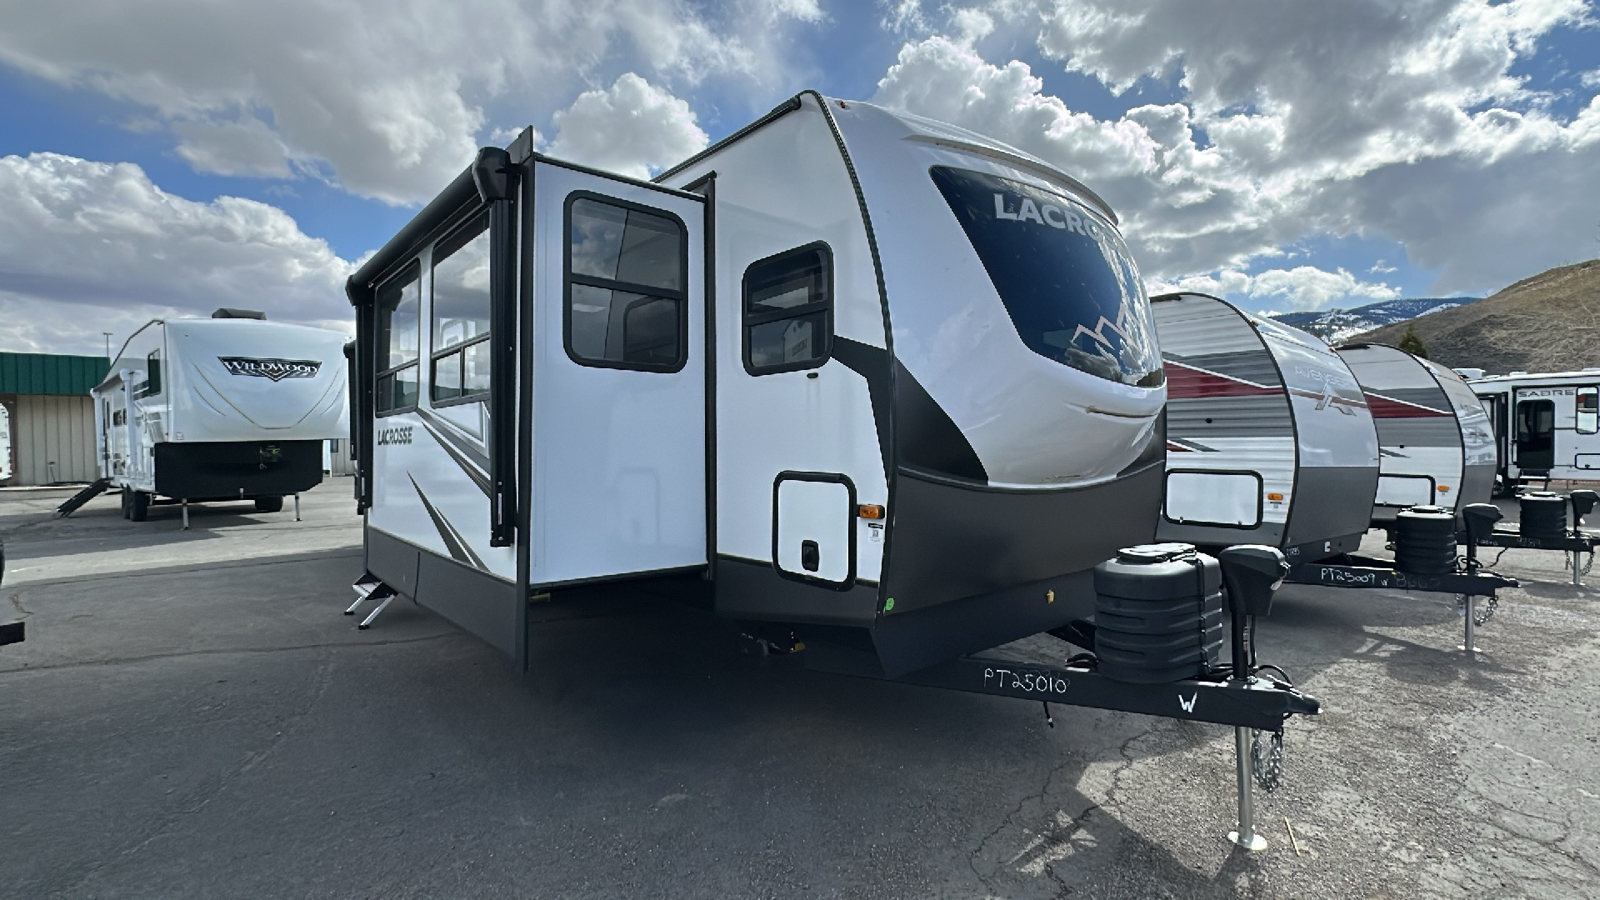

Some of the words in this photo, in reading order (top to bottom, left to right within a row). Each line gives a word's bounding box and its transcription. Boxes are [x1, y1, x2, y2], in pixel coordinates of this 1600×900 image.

[223, 361, 318, 373] WILDWOOD
[1517, 389, 1575, 398] SABRE
[377, 426, 413, 446] LACROSSE
[1321, 567, 1375, 584] PT25009
[984, 668, 1068, 693] PT25010
[1178, 692, 1198, 713] W
